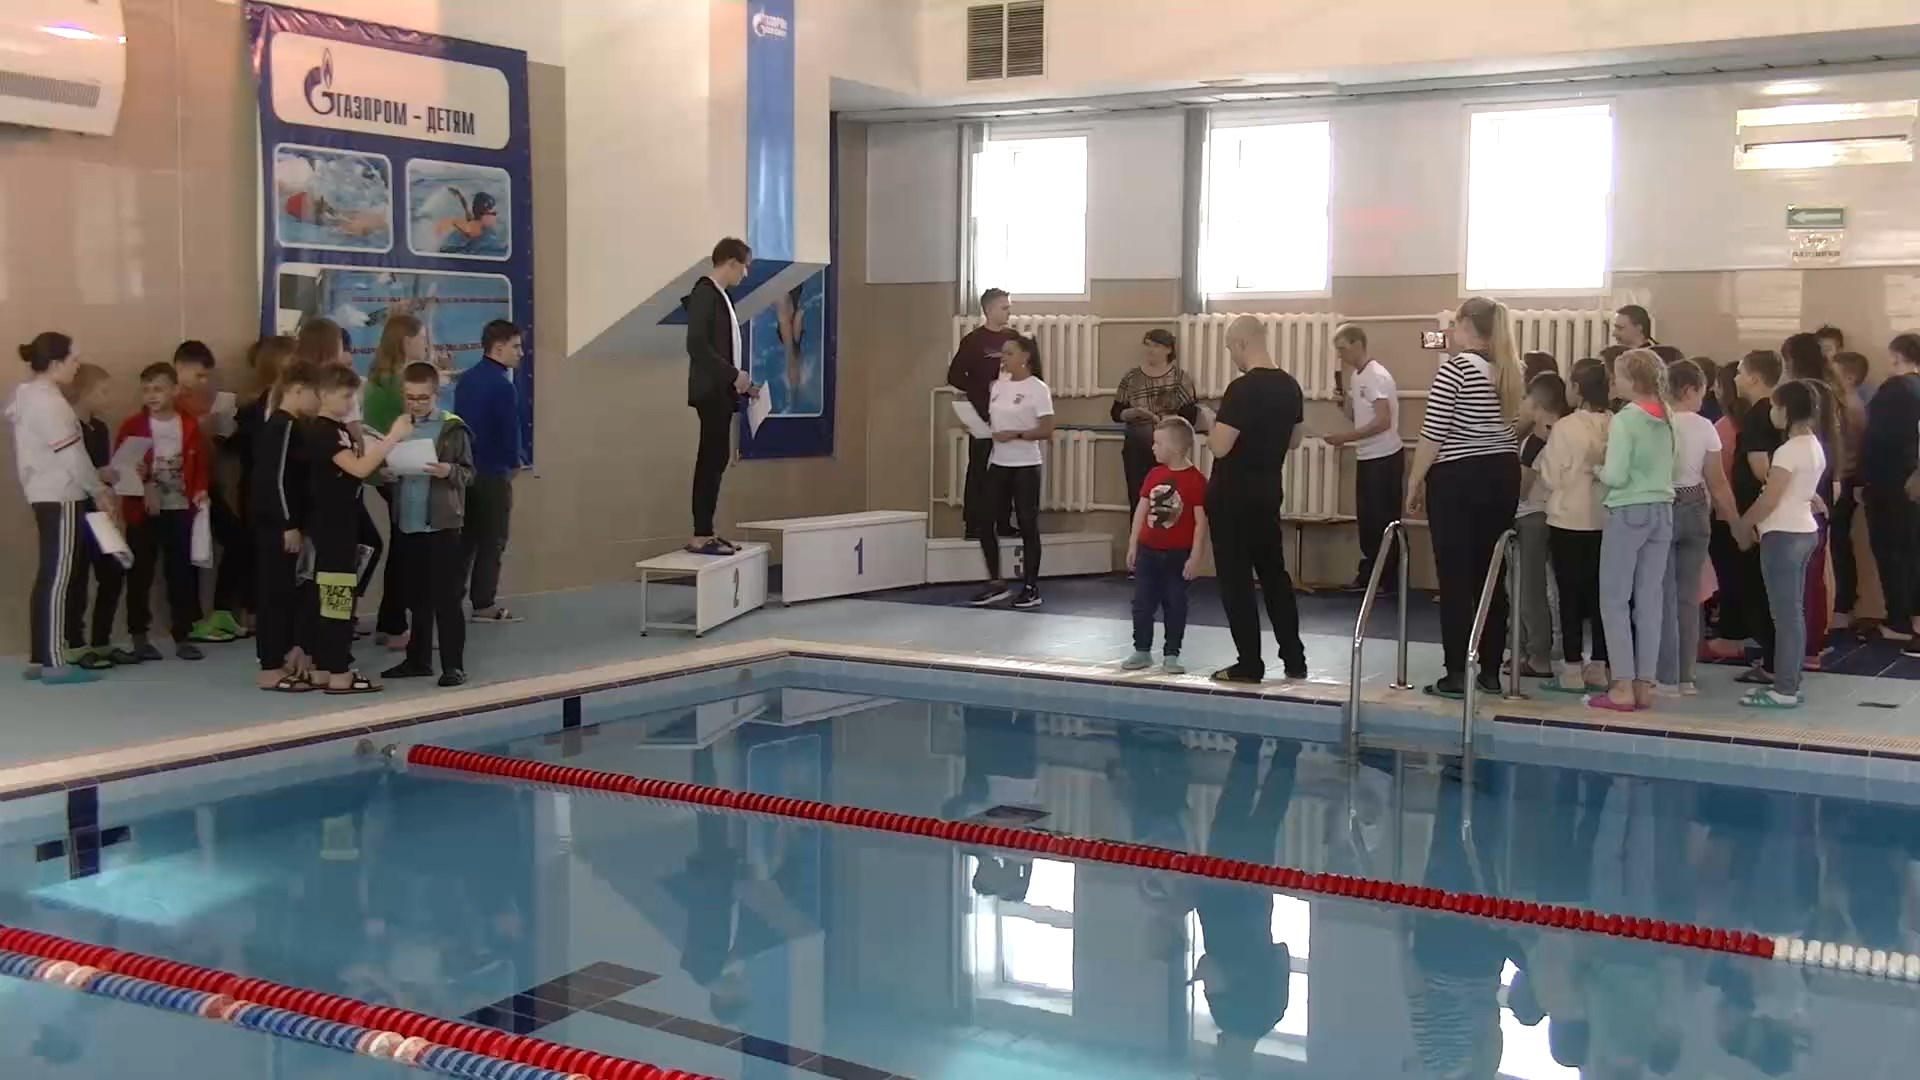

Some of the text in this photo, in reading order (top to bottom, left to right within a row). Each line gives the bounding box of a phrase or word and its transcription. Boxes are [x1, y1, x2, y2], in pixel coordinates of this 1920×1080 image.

[336, 93, 408, 126] ГАЗПРОМ
[426, 106, 476, 136] ДЕТЯМ
[854, 537, 863, 575] 1
[733, 567, 740, 609] 2
